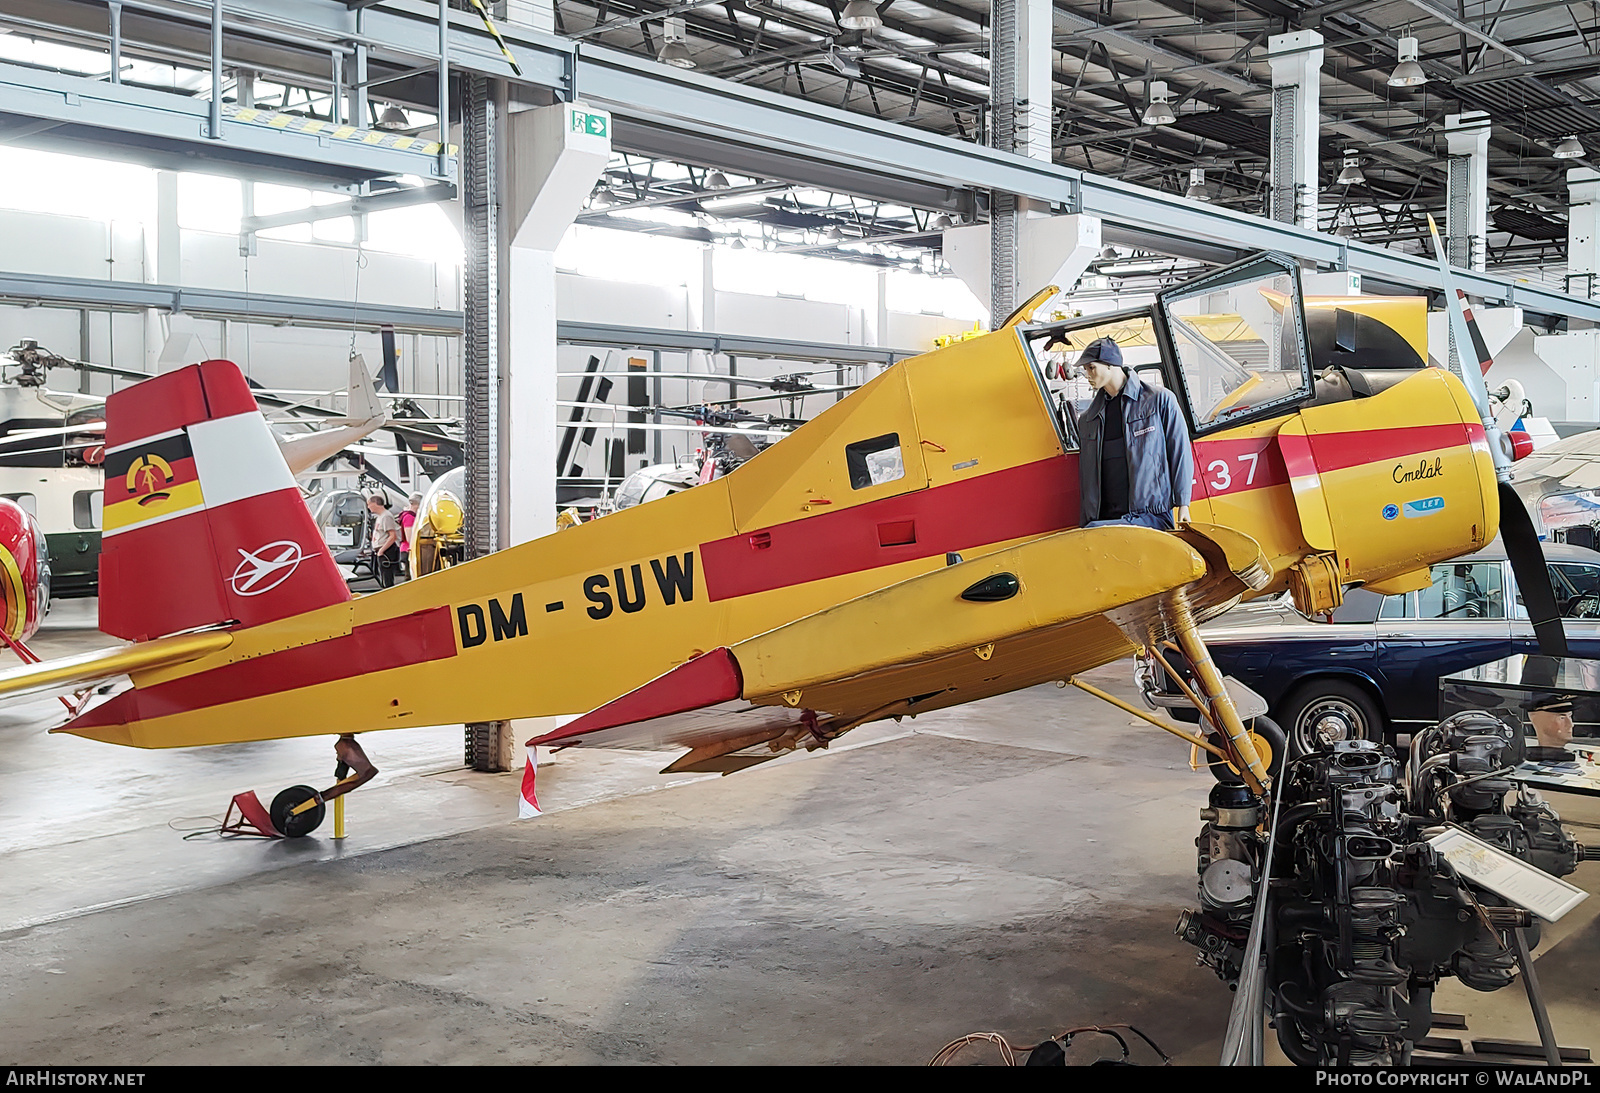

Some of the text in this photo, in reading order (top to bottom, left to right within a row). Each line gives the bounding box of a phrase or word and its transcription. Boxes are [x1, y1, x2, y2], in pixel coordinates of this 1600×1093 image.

[424, 455, 453, 466] HEER
[1392, 456, 1443, 484] Čmelák
[1422, 498, 1441, 509] LET
